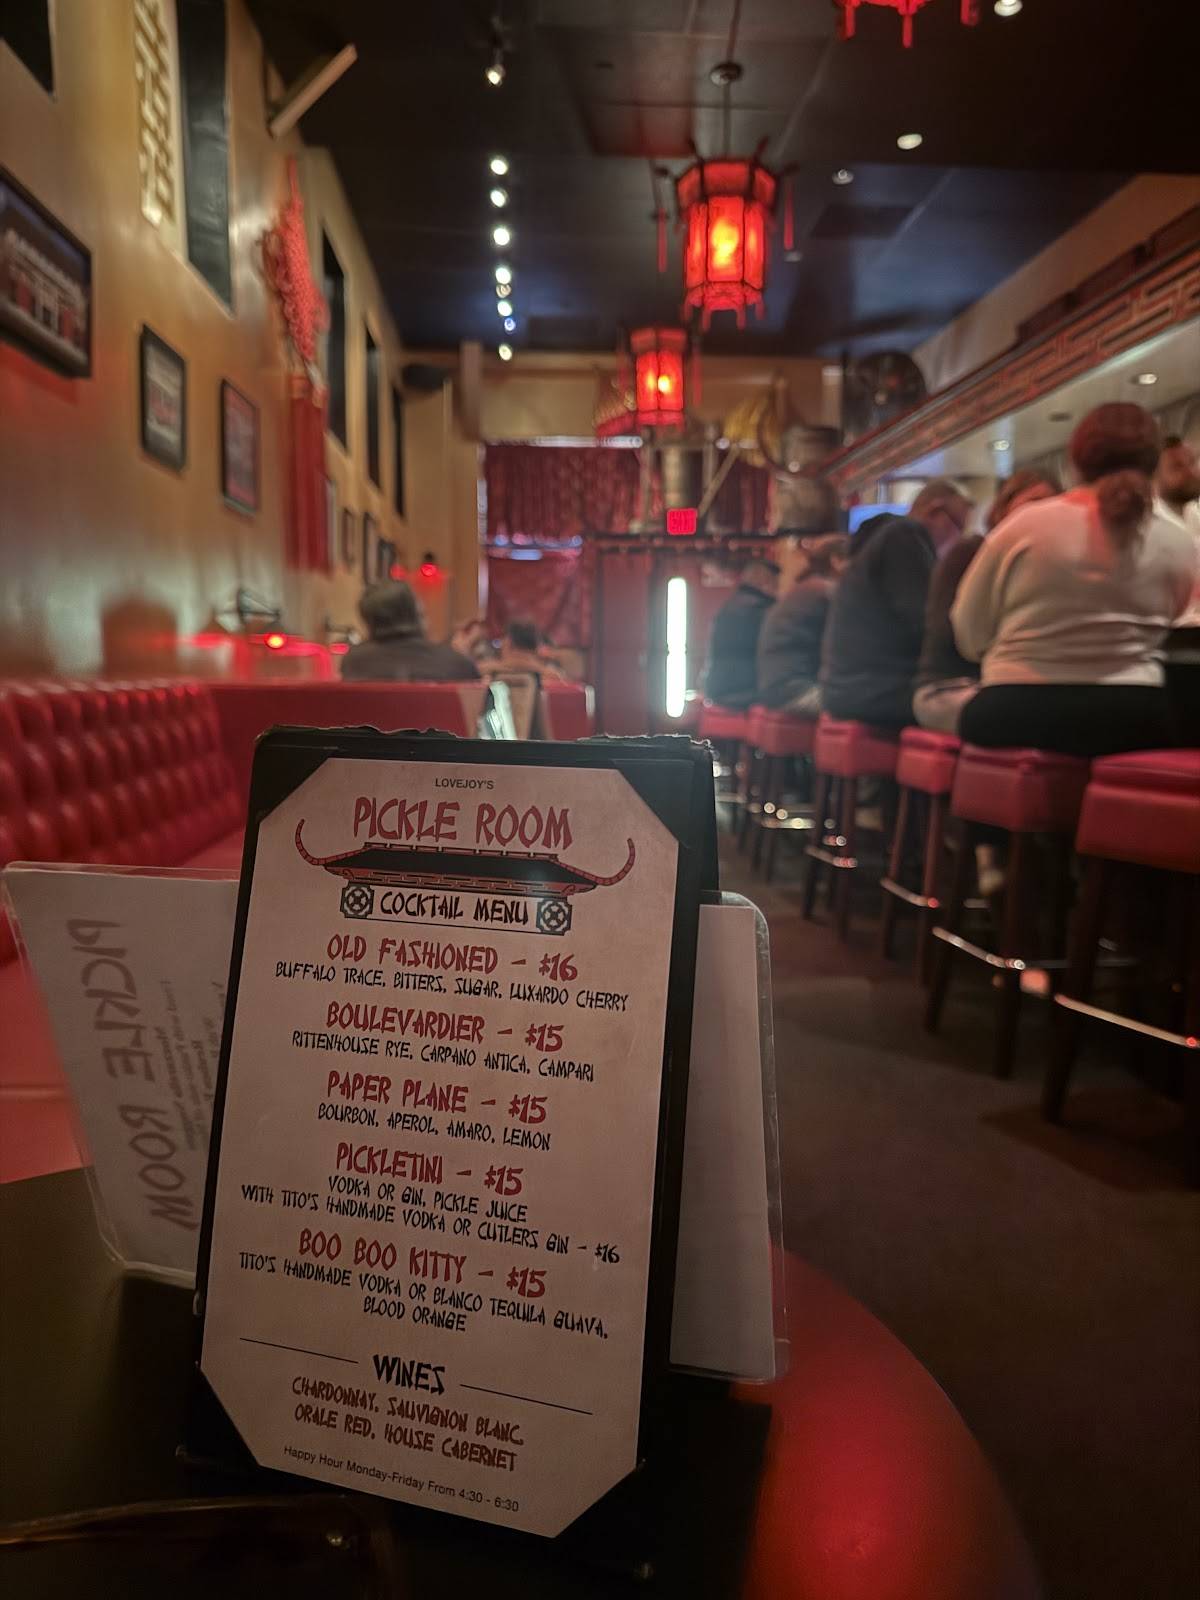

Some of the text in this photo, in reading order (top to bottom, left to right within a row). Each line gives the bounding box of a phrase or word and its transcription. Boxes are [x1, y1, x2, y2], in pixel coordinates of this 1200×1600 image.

[435, 778, 494, 790] LOVEJOY'S
[354, 797, 574, 850] PICKLE ROOM
[380, 892, 528, 925] COCKTAIL MENU
[327, 934, 367, 962] OLD
[378, 938, 498, 974] FASHIONED
[538, 953, 578, 982] $16
[275, 961, 336, 982] BUFFALO
[510, 983, 569, 1005] LUXARDO
[576, 990, 628, 1012] CHERRY
[326, 1001, 485, 1044] BOULEVARDIER
[525, 1023, 564, 1052] $15
[292, 1030, 379, 1055] RITTENHOUSE
[421, 1044, 476, 1066] CARPANO
[538, 1058, 594, 1082] CAMPARI
[327, 1070, 392, 1105] PAPER
[402, 1079, 469, 1113] PLANE
[508, 1094, 548, 1124] $15
[503, 1127, 551, 1151] LEMON
[336, 1142, 443, 1185] PICKLETINI
[483, 1165, 524, 1196] $15
[241, 1184, 275, 1203] WITH
[281, 1189, 319, 1211] TITO'S
[326, 1197, 395, 1224] HANDMADE
[402, 1209, 445, 1233] VODKA
[453, 1218, 471, 1237] OR
[478, 1222, 539, 1251] CUTLERS
[546, 1233, 569, 1255] GIN
[594, 1244, 621, 1264] $16
[329, 1176, 371, 1197] VODKA
[377, 1183, 395, 1200] OR
[433, 1191, 478, 1215] PICKLE
[486, 1200, 528, 1223] JUICE
[239, 1251, 276, 1273] TITO'S
[283, 1260, 352, 1287] HANDMADE
[359, 1270, 400, 1295] VODKA
[408, 1282, 426, 1299] OR
[433, 1286, 482, 1312] BLANCO
[490, 1298, 545, 1326] TEQUILA
[299, 1228, 342, 1260] BOO
[354, 1236, 397, 1270] BOO
[409, 1246, 467, 1284] KITTY
[506, 1266, 547, 1298] $15
[363, 1296, 466, 1332] BLOOD ORANGE
[373, 1354, 445, 1396] WINES
[295, 1403, 338, 1429] ORALE
[384, 1424, 435, 1452] HOUSE
[441, 1438, 517, 1472] CABERNET
[387, 1397, 468, 1432] SAUVIGNON
[284, 1445, 316, 1464] Happy
[319, 1455, 343, 1470] Hour
[346, 1461, 425, 1492] Monday-Friday
[428, 1481, 456, 1497] From
[459, 1490, 483, 1504] 4:30
[494, 1497, 519, 1512] 6:30
